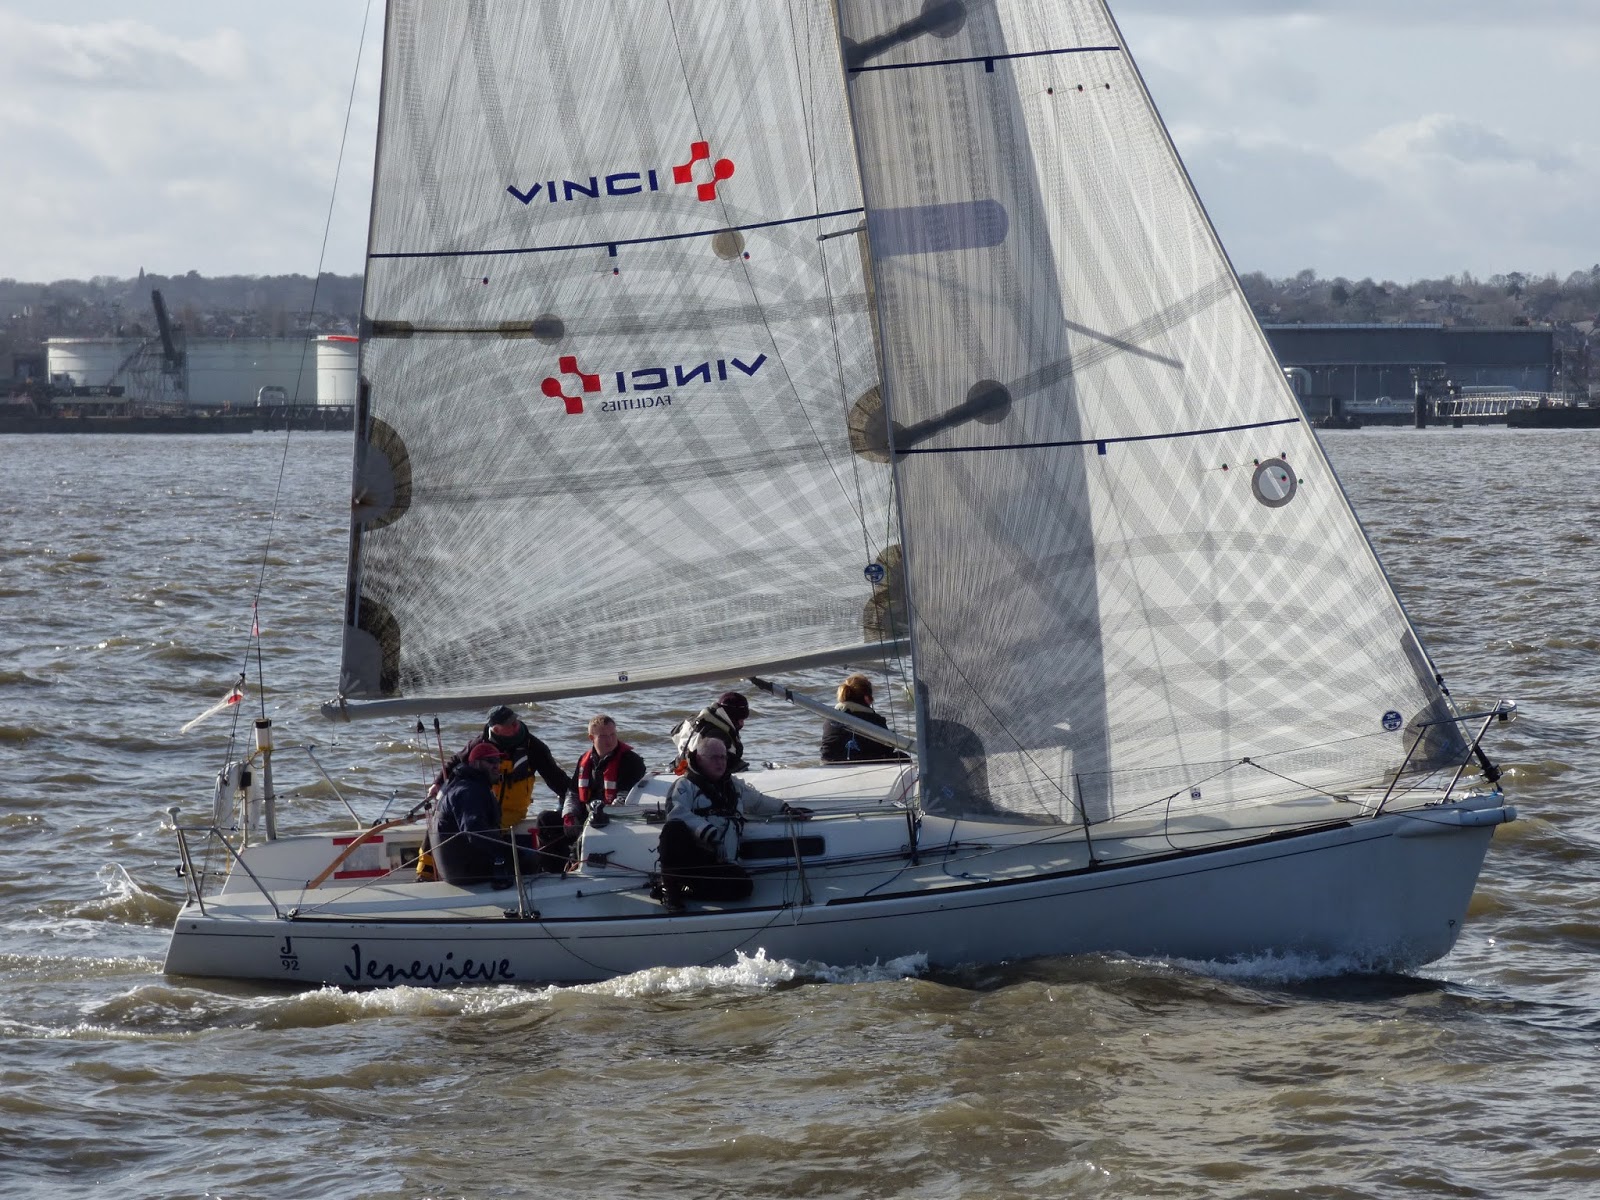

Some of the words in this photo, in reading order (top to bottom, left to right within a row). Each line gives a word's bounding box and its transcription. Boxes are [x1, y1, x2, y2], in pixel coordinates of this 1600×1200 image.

[506, 169, 659, 205] VINCI
[281, 959, 300, 971] 92
[344, 943, 515, 983] Jenevieve
